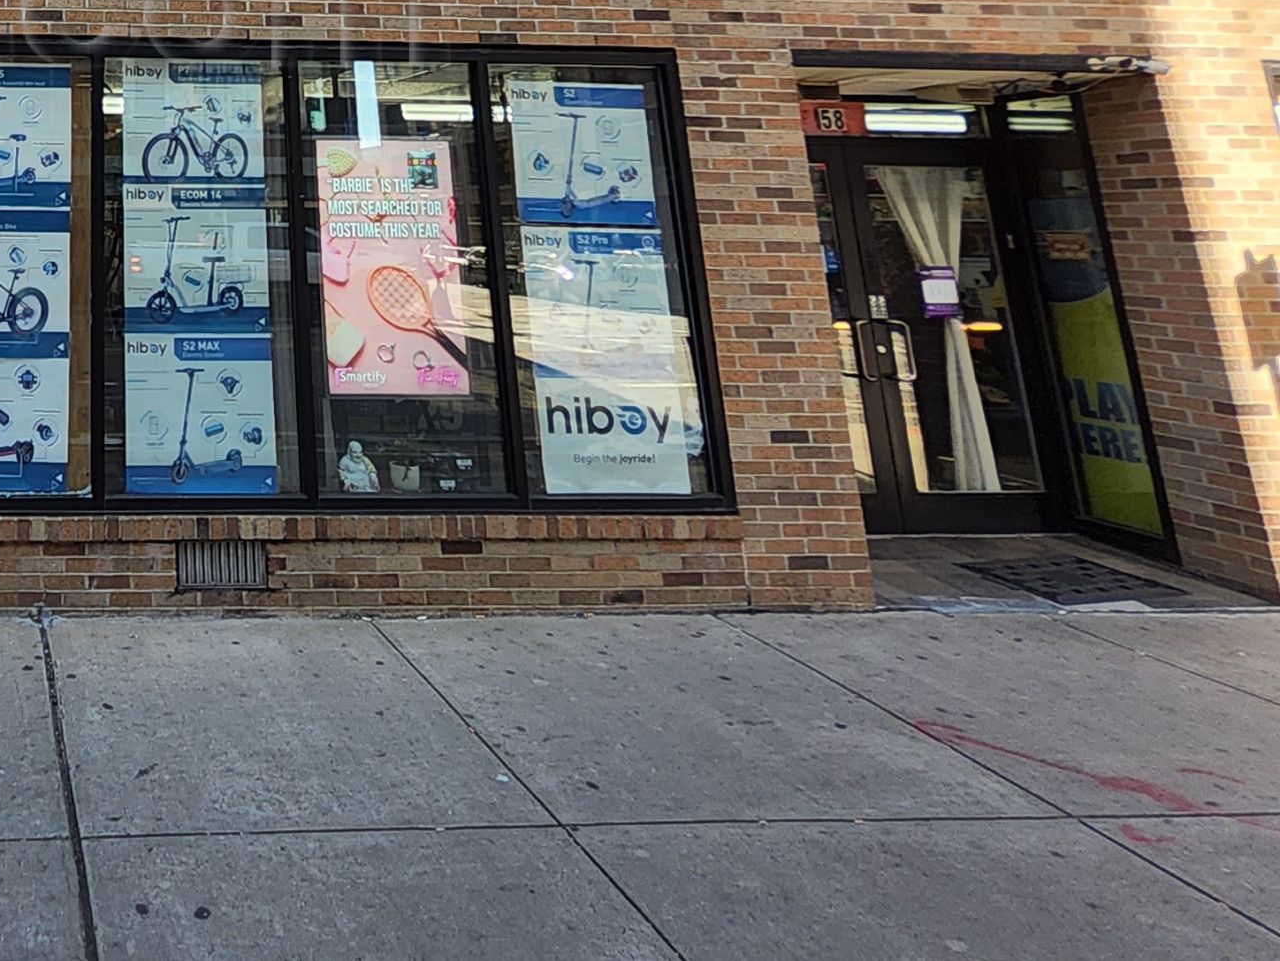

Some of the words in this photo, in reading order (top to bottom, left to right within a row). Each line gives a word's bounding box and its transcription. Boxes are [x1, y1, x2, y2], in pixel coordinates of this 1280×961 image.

[820, 109, 845, 130] 58
[380, 179, 391, 193] IS
[393, 179, 416, 193] THE
[126, 187, 164, 202] hiboy
[180, 190, 208, 200] ECOM
[328, 200, 358, 215] MOST
[361, 200, 418, 216] SEARCHED
[420, 200, 442, 216] FOR
[329, 222, 381, 238] COSTUME
[383, 222, 408, 238] THIS
[410, 222, 440, 238] YEAR
[591, 235, 609, 245] Pro
[127, 342, 166, 356] hiboy
[182, 341, 196, 351] S2
[198, 341, 220, 351] MAX
[339, 371, 387, 384] Smartify
[545, 396, 671, 444] hiboy
[573, 454, 600, 466] Begin
[602, 453, 617, 464] the
